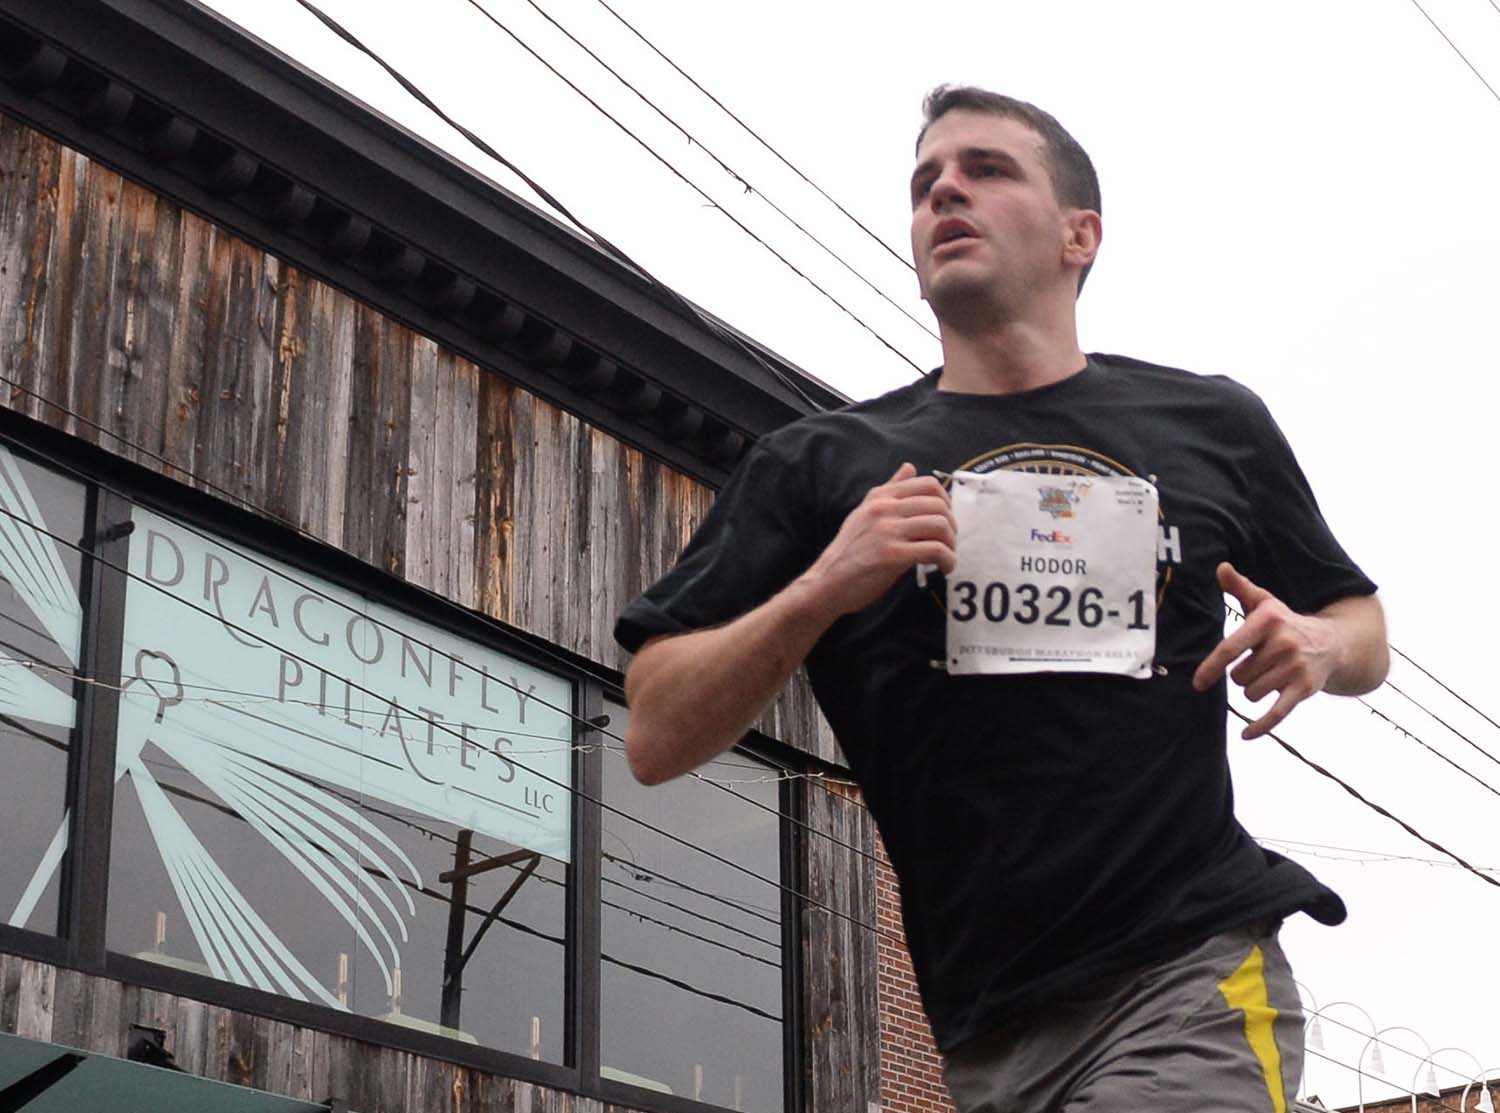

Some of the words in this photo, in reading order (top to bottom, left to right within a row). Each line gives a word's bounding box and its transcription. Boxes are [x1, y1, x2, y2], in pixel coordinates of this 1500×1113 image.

[1030, 528, 1072, 544] FedEx
[1020, 556, 1088, 576] HODOR
[951, 581, 1150, 631] 30326-1
[145, 529, 537, 724] DRAGONFLY
[277, 654, 516, 785] PILATES
[524, 786, 555, 815] LLC
